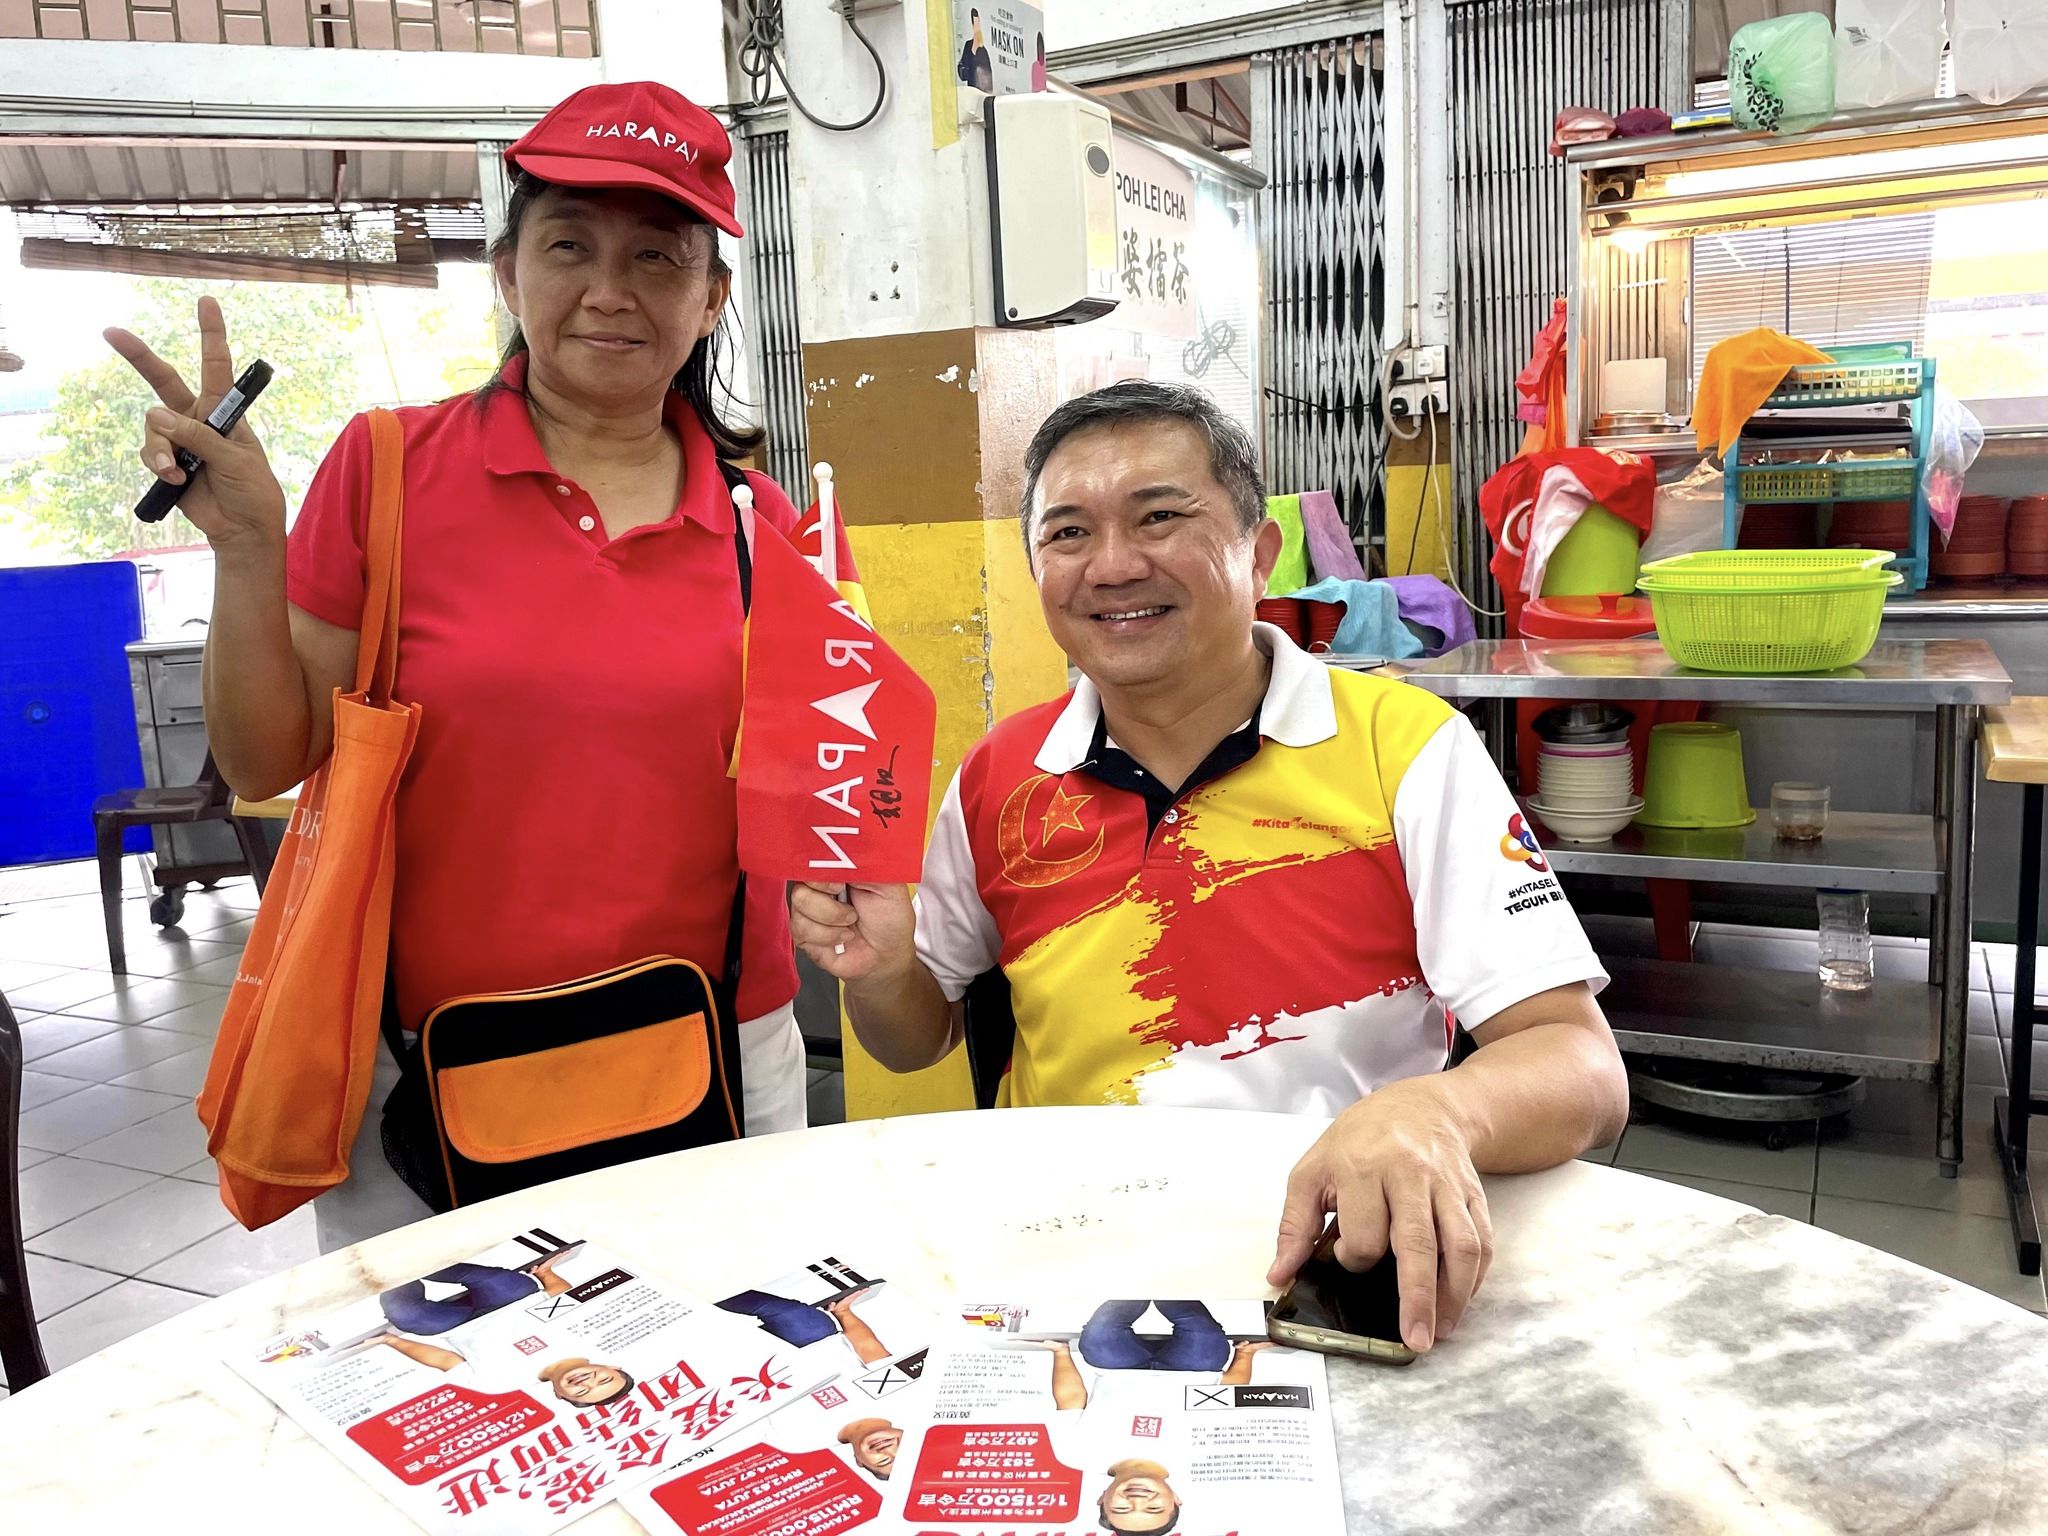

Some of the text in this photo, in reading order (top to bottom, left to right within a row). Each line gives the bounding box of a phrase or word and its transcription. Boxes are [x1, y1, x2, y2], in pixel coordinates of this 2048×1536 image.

[991, 26, 1025, 58] MASK ON
[586, 122, 699, 168] HARAPA
[1144, 182, 1161, 213] LEI
[1163, 189, 1187, 222] CHA
[1504, 894, 1549, 915] TEGUH
[577, 1275, 622, 1297] HARAPAN
[1243, 1392, 1299, 1402] HARAPAN
[436, 1360, 706, 1517] 团结前进
[816, 1467, 838, 1480] DUN
[700, 1477, 736, 1496] JUTA
[787, 1480, 824, 1500] JUMLAH
[713, 1490, 751, 1511] JUTA
[917, 1493, 1068, 1507] 1亿1500万令吉
[806, 1514, 851, 1536] TAHUN
